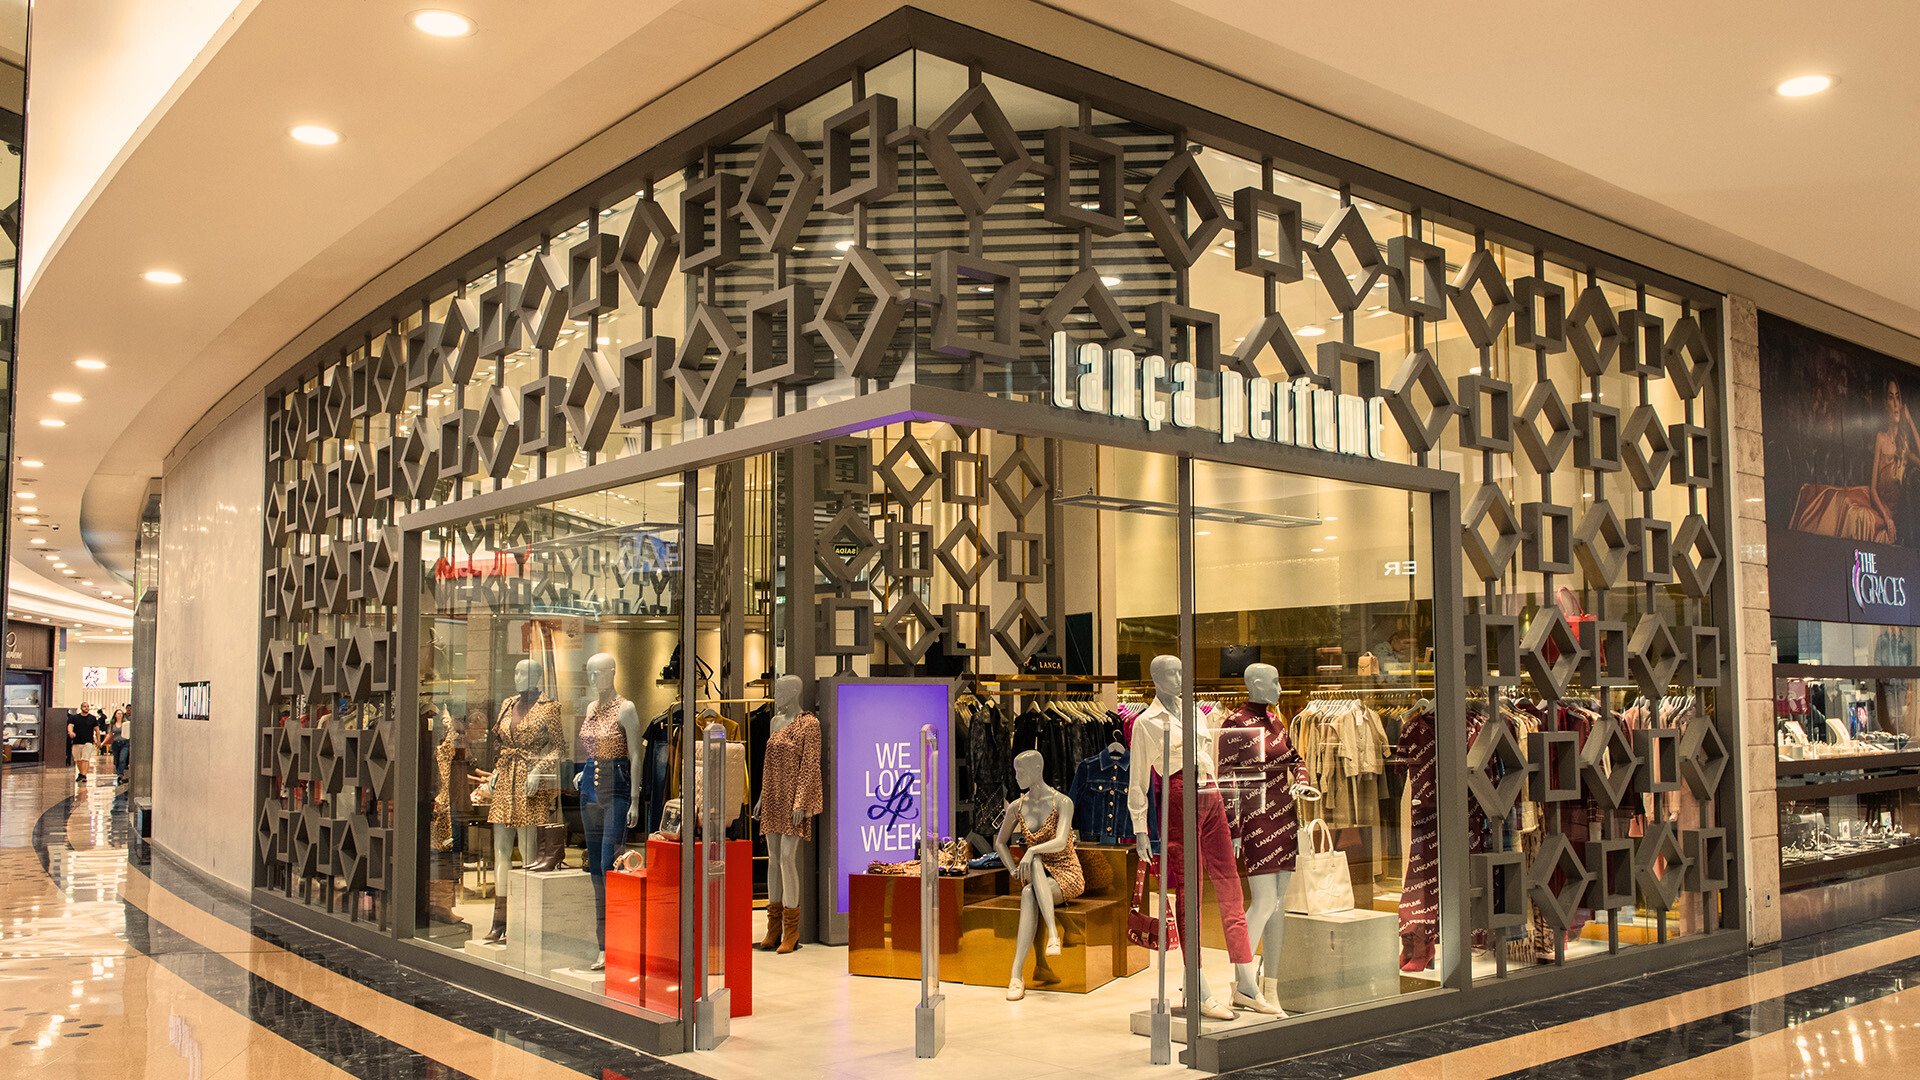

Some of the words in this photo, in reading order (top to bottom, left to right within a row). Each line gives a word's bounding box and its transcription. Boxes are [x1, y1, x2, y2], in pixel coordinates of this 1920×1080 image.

[1220, 371, 1386, 460] perfume
[1858, 551, 1878, 574] THE
[1860, 573, 1906, 607] GRACES
[875, 742, 911, 769] WE
[865, 769, 921, 797] LOVE
[860, 823, 921, 852] WEEK
